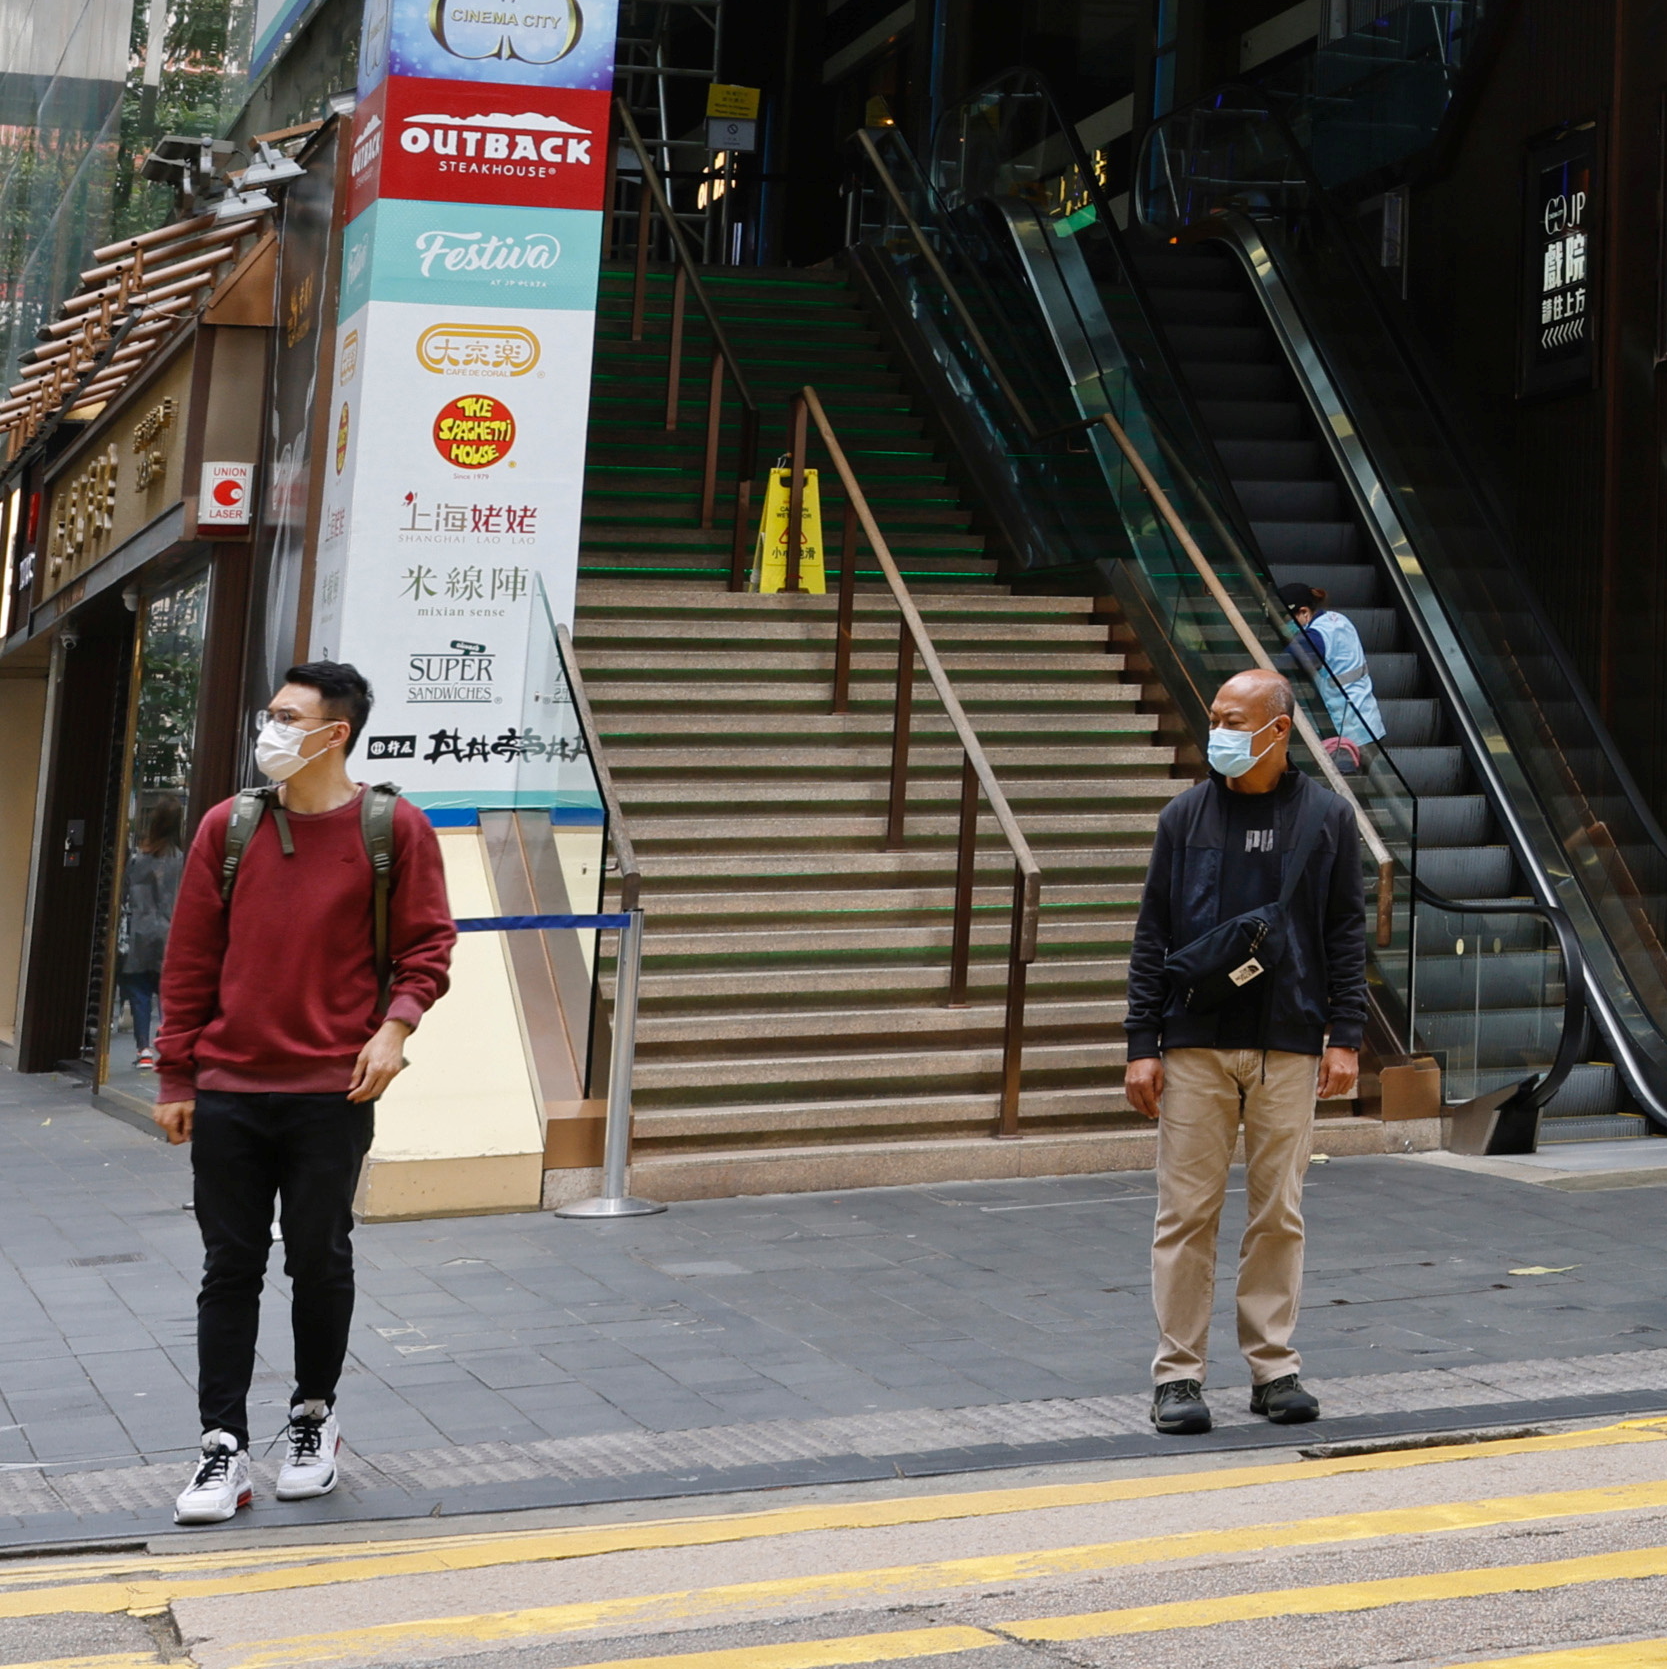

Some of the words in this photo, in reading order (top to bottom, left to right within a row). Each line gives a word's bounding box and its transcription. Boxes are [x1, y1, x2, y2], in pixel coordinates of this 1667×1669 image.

[450, 8, 519, 27] CINEMA
[521, 13, 562, 30] CITY
[400, 126, 593, 166] OUTBACK
[438, 160, 547, 179] STEAKHOUSE
[1567, 191, 1587, 228] JP
[415, 230, 561, 278] Festiva
[1543, 233, 1587, 292] 戲院
[468, 369, 481, 377] DE
[481, 370, 510, 378] CORAL
[456, 397, 495, 418] THE
[450, 443, 499, 466] HOUSE
[213, 467, 247, 477] UNION
[453, 472, 471, 480] Since
[473, 473, 490, 481] 1979
[208, 508, 243, 520] LASER
[399, 502, 538, 534] 上海姥姥
[398, 534, 466, 544] SHANGHAI
[476, 536, 501, 545] LAO
[511, 536, 536, 546] LAO
[399, 564, 529, 602] 米線陣
[417, 606, 465, 617] mixian
[470, 608, 506, 618] sense
[408, 657, 494, 682] SUPER
[408, 682, 493, 701] SANDWICHES
